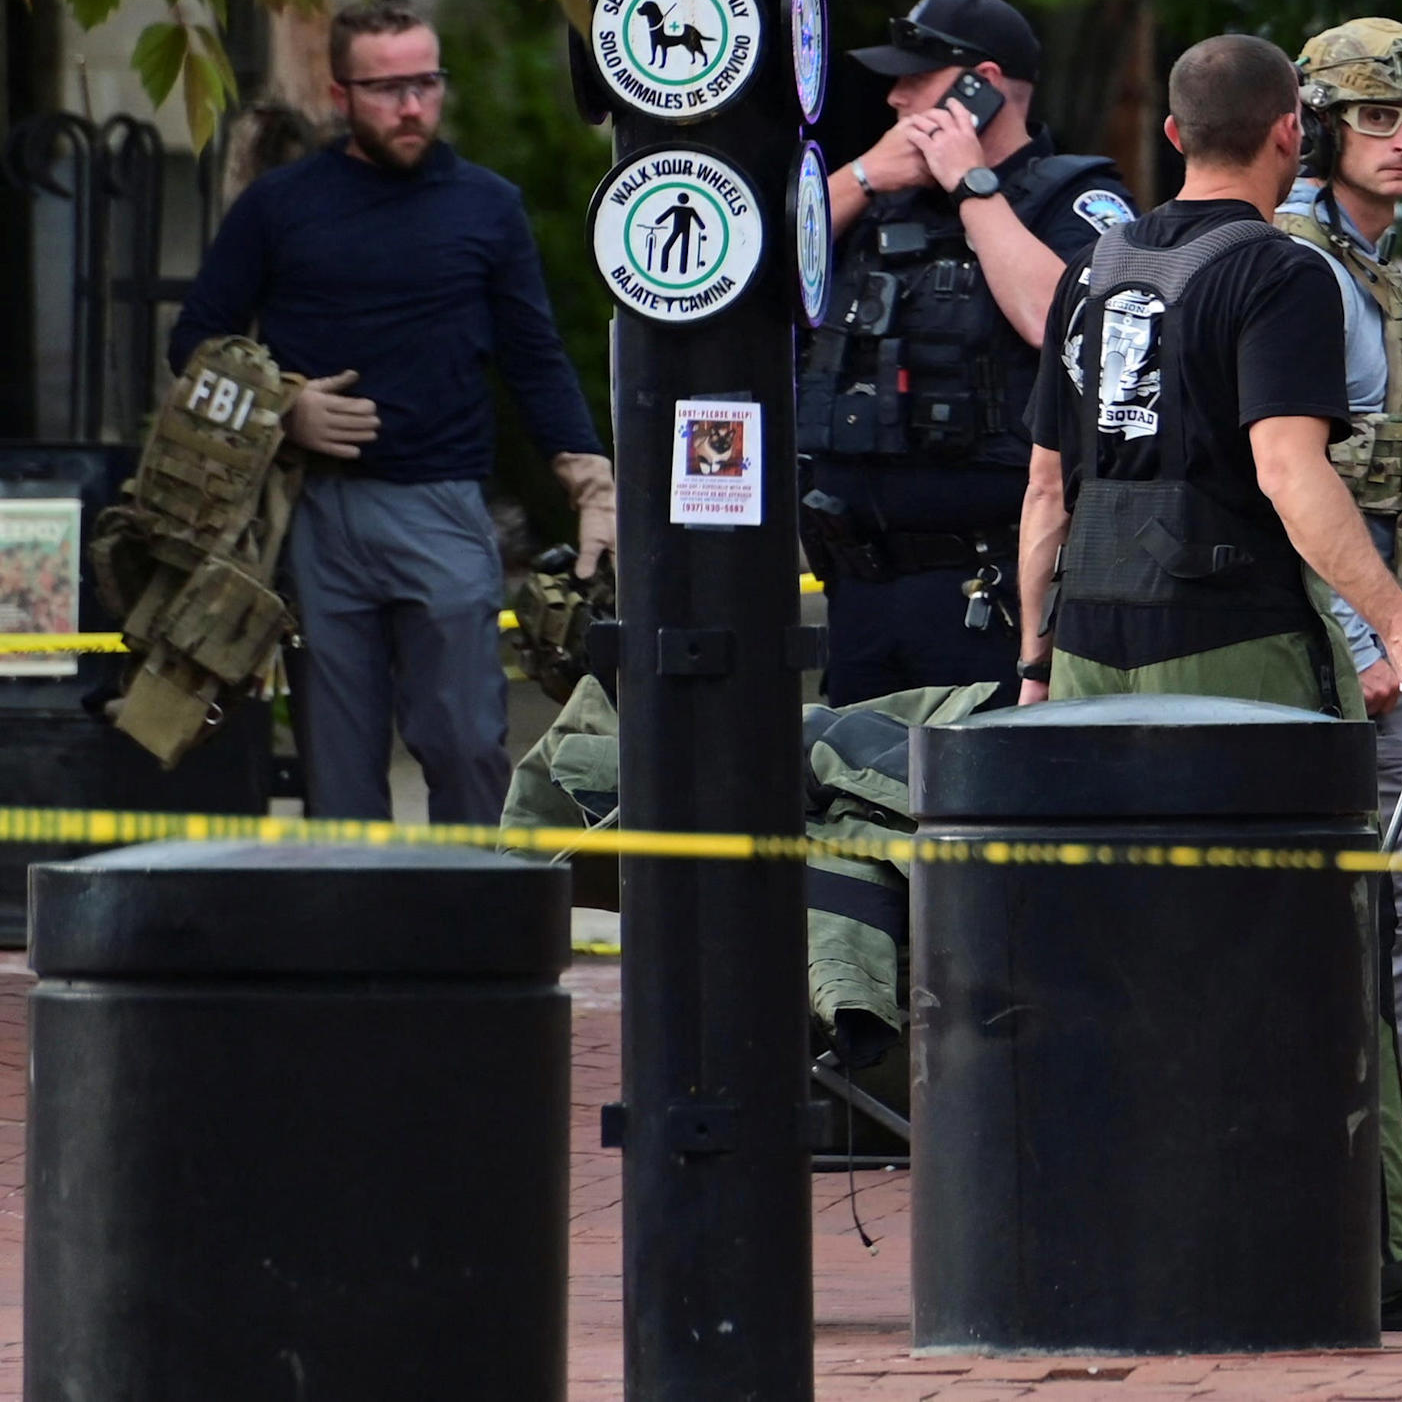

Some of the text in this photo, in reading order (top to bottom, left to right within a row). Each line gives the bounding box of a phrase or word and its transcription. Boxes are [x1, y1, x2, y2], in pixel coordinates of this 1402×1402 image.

[600, 30, 751, 110] SOLO ANIMALES DE SERVICIO
[609, 158, 747, 217] WALK YOUR WHEELS
[611, 264, 736, 313] BÁJATE Y CAMINA
[185, 367, 255, 431] FBI
[1106, 409, 1154, 425] SQUAD
